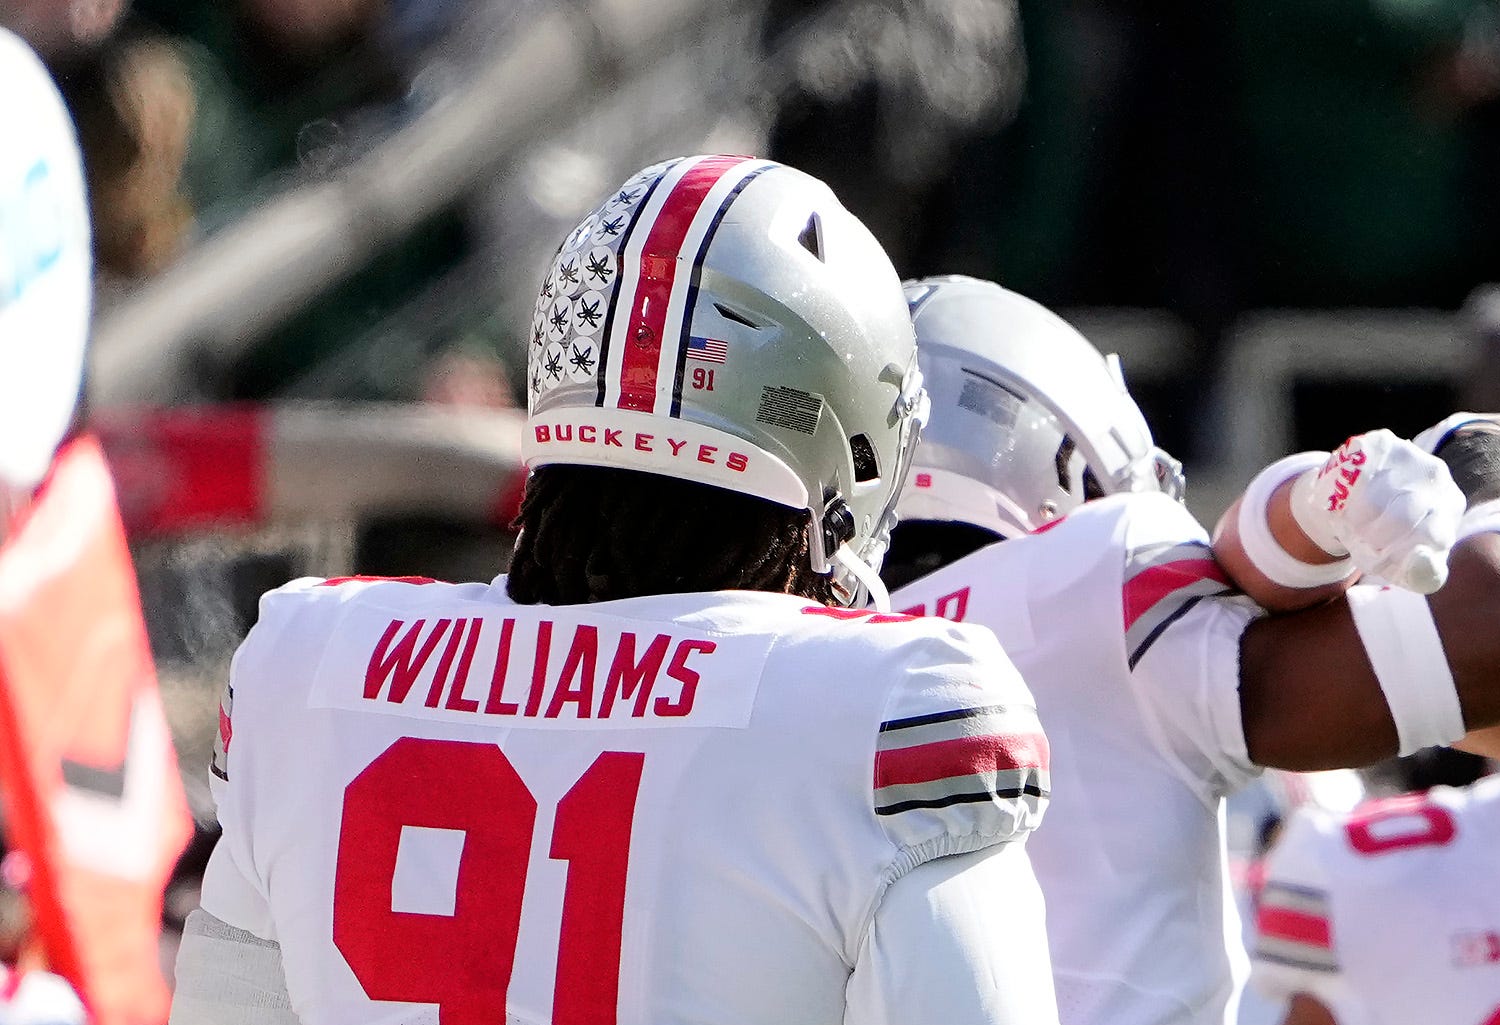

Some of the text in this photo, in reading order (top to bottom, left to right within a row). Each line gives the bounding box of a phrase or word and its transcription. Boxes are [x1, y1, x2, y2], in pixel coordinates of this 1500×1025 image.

[691, 367, 714, 392] 91
[535, 424, 748, 472] BUCKEYES
[363, 618, 717, 719] WILLIAMS
